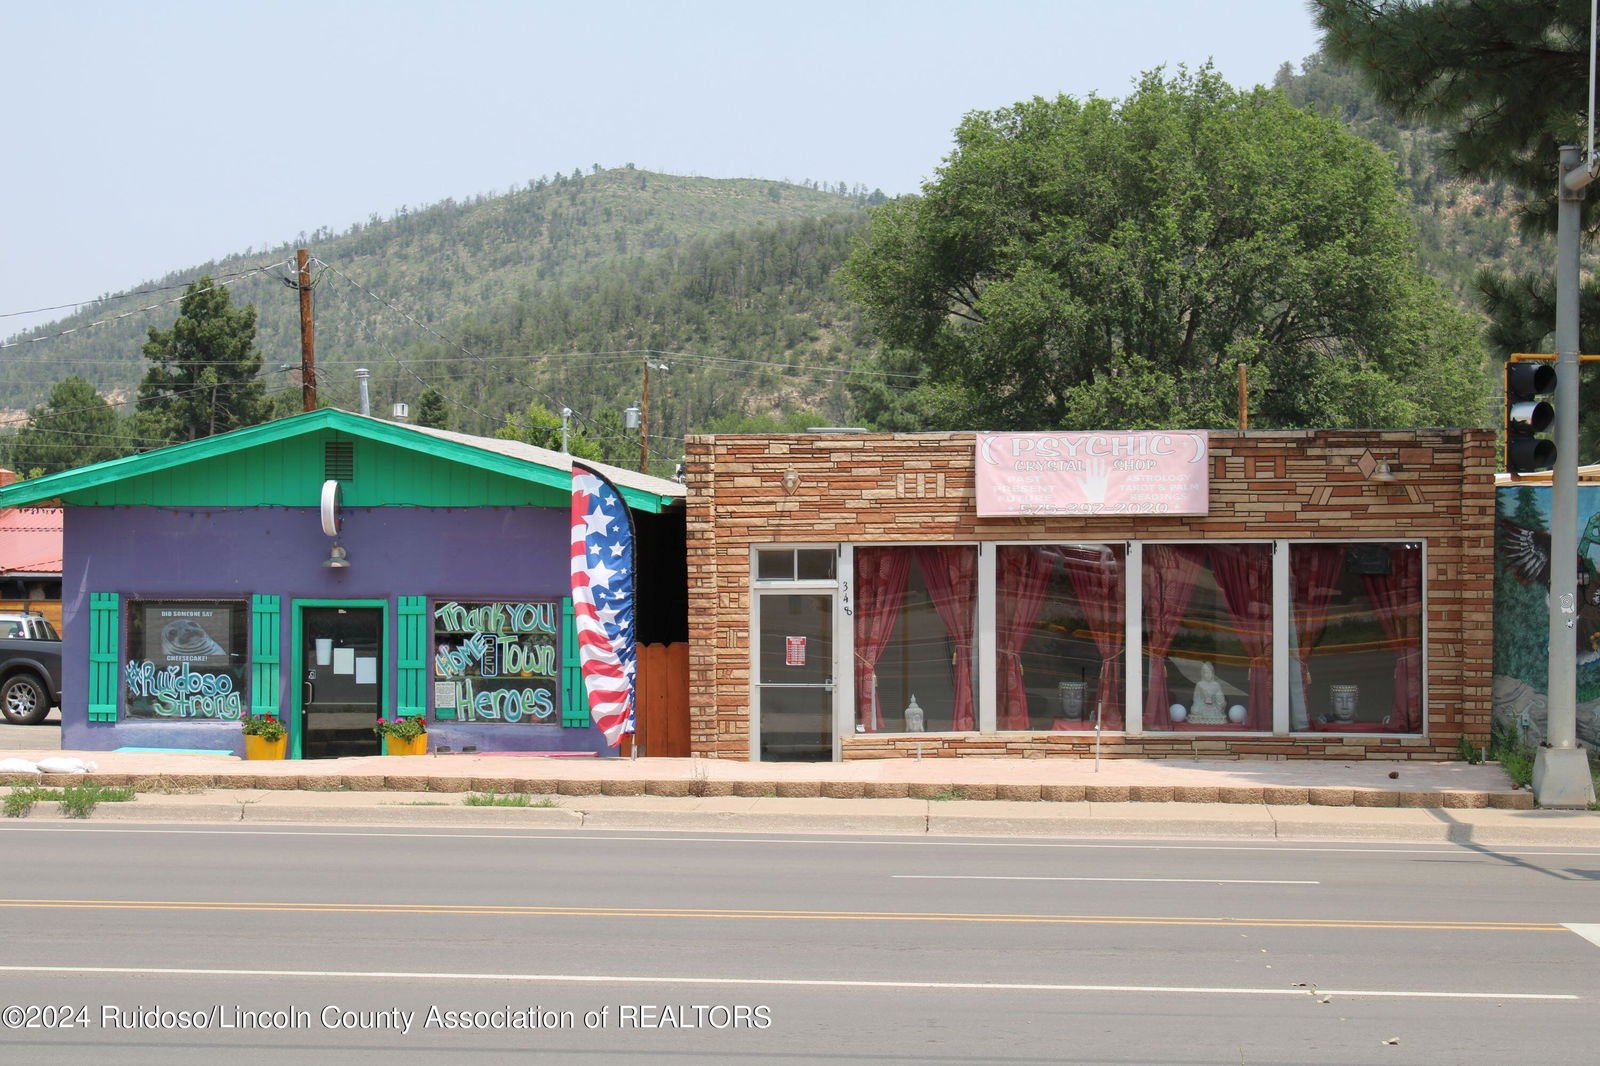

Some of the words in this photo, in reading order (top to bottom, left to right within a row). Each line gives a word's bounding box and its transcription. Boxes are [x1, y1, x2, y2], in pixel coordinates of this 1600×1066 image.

[1011, 435, 1176, 457] PSYCHIC
[1007, 475, 1041, 483] PAST
[1014, 459, 1086, 472] CRYSTAL
[1112, 458, 1157, 472] SHOP
[1125, 474, 1193, 482] ASTROLOGY
[842, 581, 853, 616] 348
[434, 601, 508, 637] Thank
[484, 637, 495, 674] OPEN
[497, 635, 557, 675] Town
[153, 688, 241, 720] Strong
[456, 678, 553, 722] Heroes
